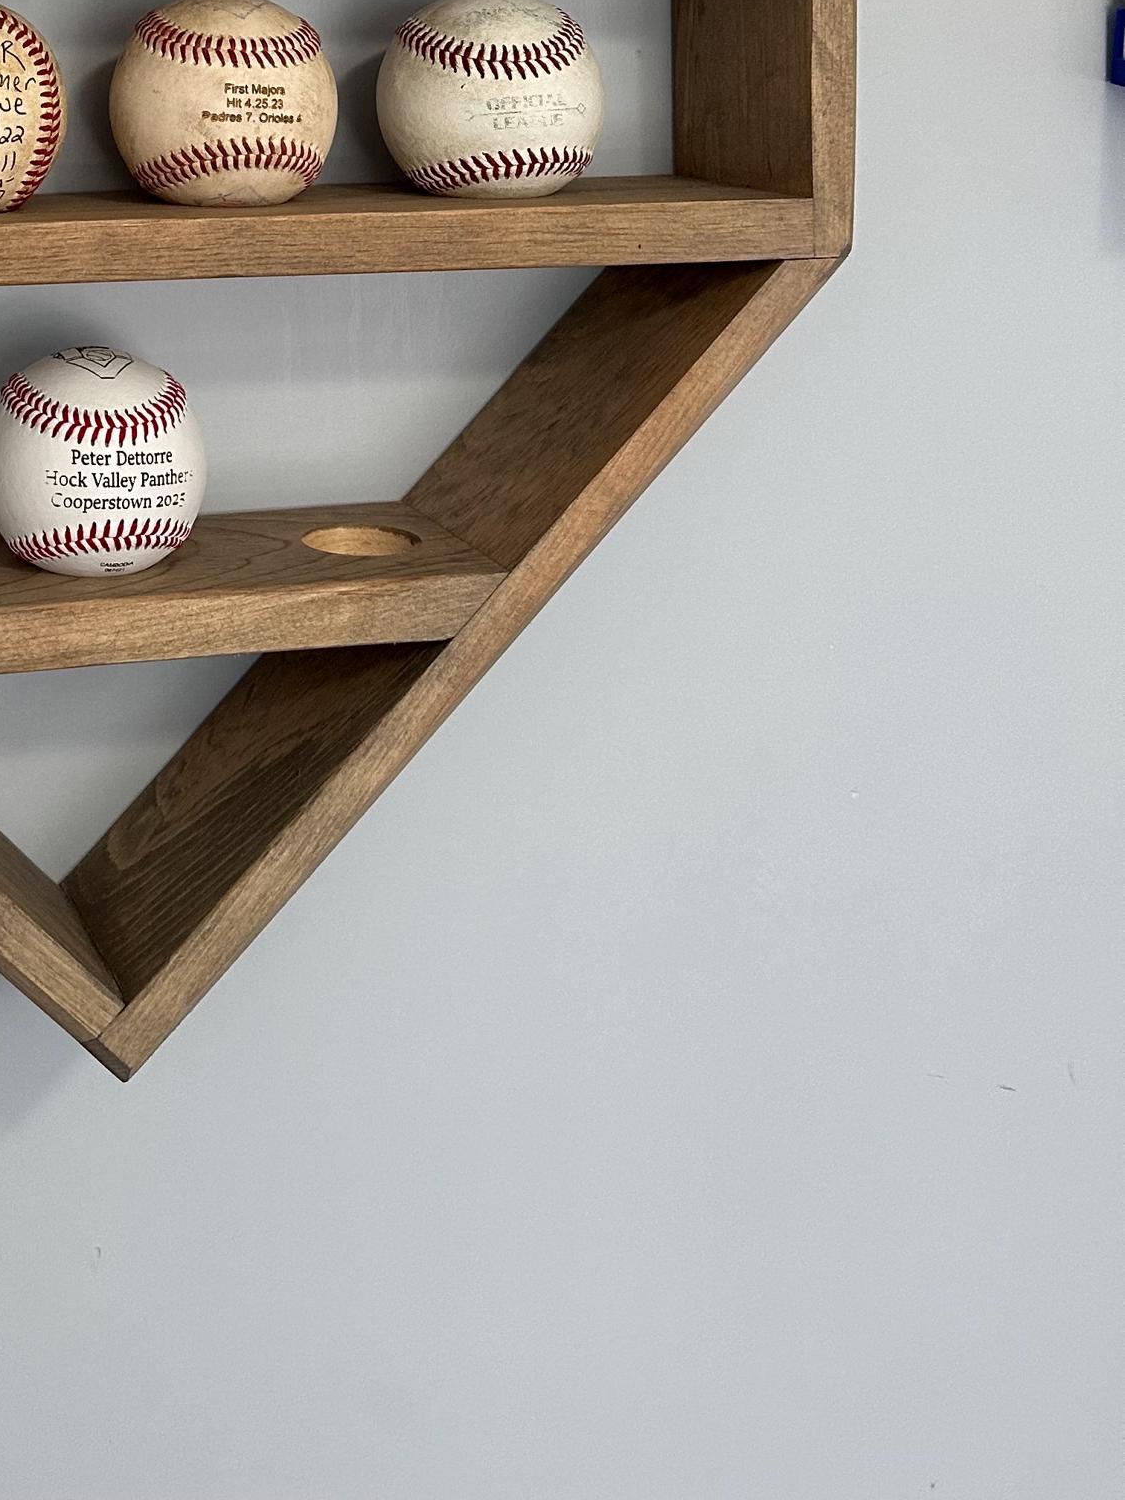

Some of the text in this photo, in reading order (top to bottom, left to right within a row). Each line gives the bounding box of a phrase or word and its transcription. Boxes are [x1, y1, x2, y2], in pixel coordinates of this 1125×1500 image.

[223, 82, 286, 97] First Majors
[226, 97, 285, 110] Hit 4.25.23
[201, 110, 243, 123] Padres
[258, 112, 295, 125] Orioles
[71, 449, 174, 466] Peter Dettorre
[44, 469, 89, 488] Hock
[91, 470, 138, 492] Valley
[50, 492, 152, 513] Cooperstown
